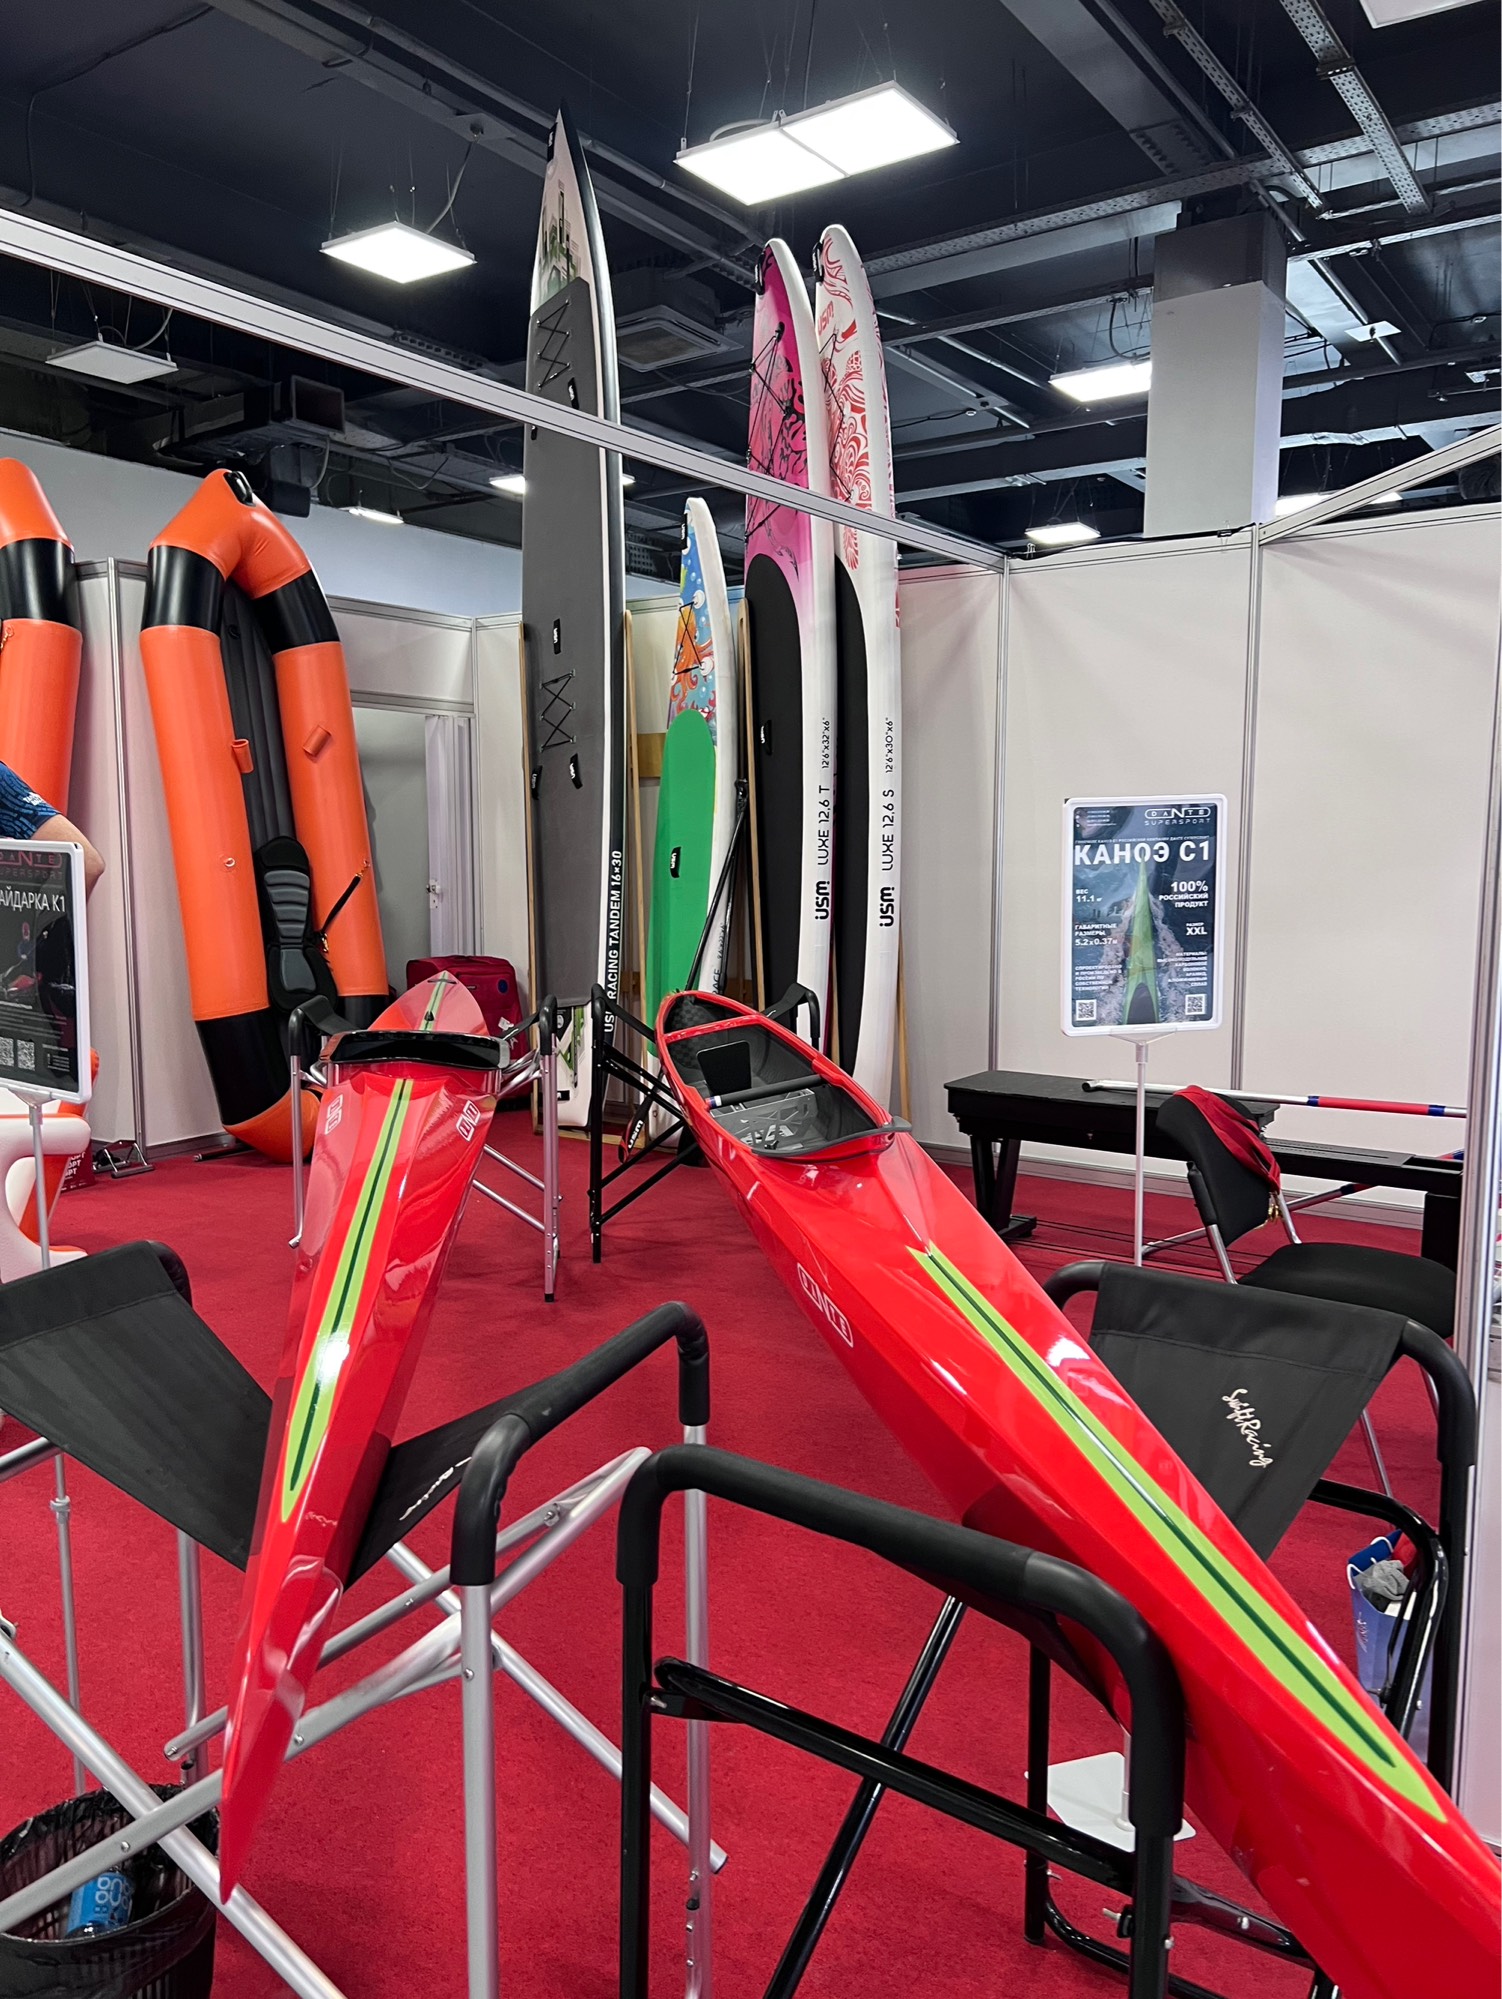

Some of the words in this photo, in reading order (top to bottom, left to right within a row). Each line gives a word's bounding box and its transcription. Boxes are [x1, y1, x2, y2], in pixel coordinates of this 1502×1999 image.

[818, 785, 830, 793] T
[883, 789, 894, 797] S
[1144, 818, 1210, 826] SUPERSPORT
[818, 829, 829, 865] LUXE
[882, 834, 893, 871] LUXE
[1075, 841, 1170, 866] КАНОЭ
[0, 867, 62, 880] PERSPORT
[1171, 880, 1209, 892] 100%
[1158, 893, 1209, 901] РОССИЙСКИЙ
[1175, 900, 1209, 908] ПРОДУКТ
[608, 890, 621, 945] TANDEM
[1186, 926, 1208, 936] XXL
[607, 950, 619, 999] RACING
[604, 1011, 615, 1032] US
